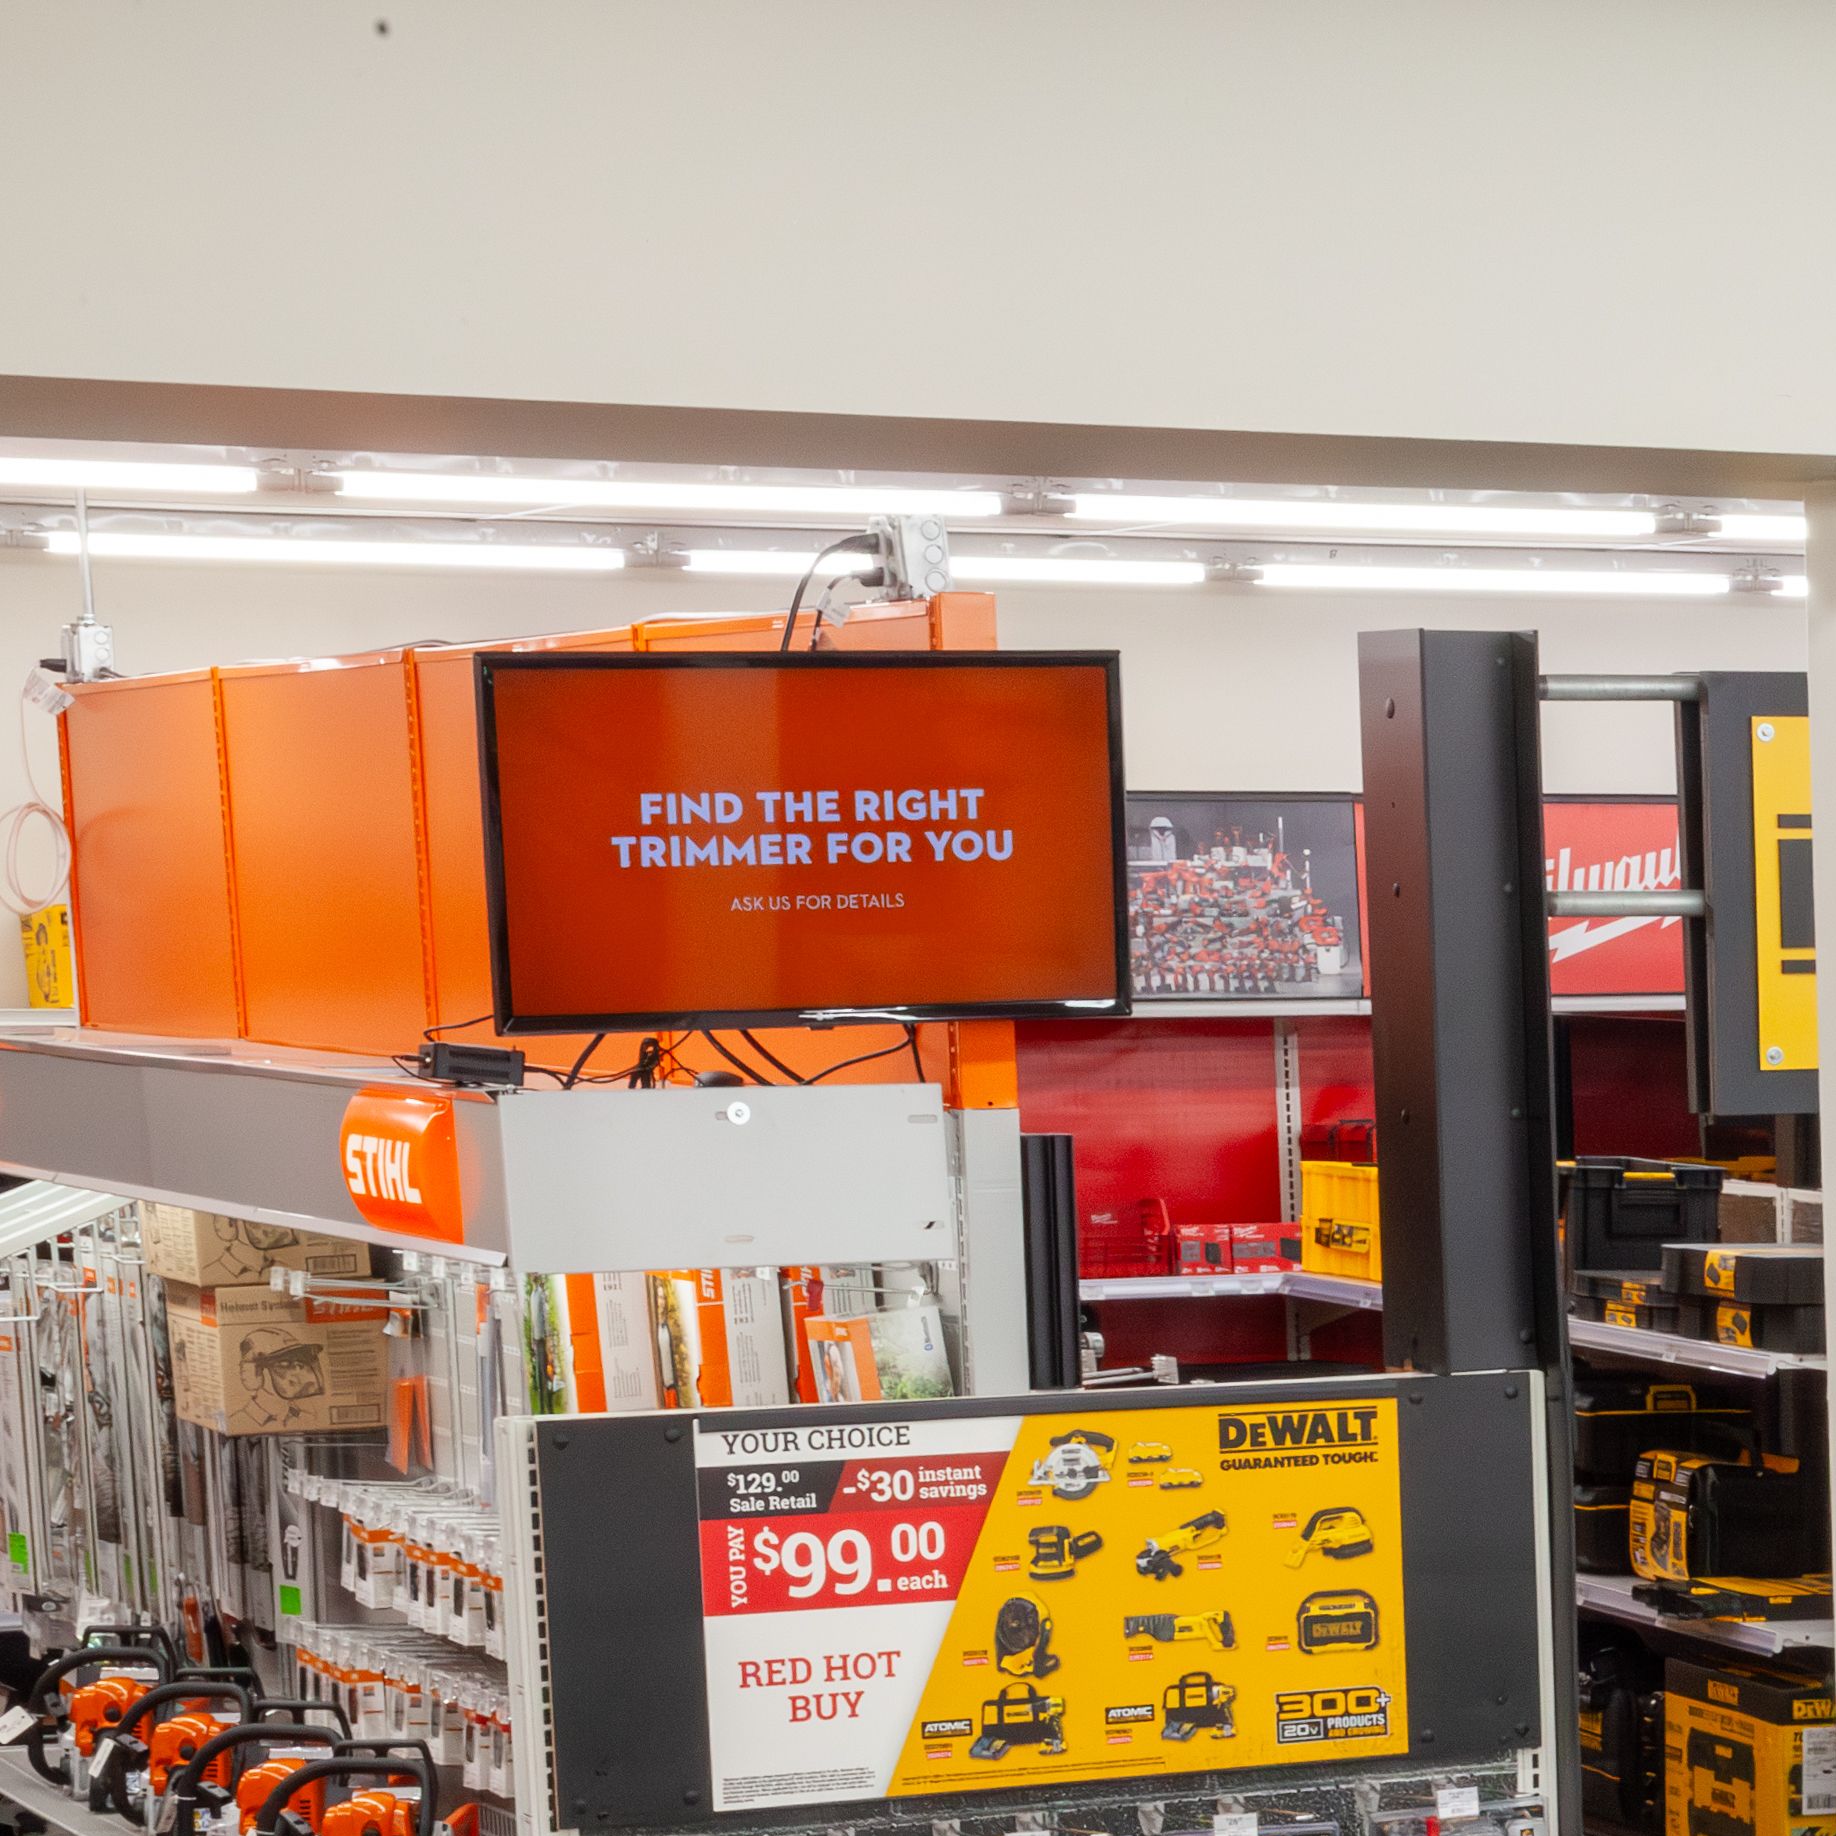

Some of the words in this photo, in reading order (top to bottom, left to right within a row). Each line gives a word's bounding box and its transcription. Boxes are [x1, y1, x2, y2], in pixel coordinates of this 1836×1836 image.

[640, 794, 743, 825] FIND
[756, 791, 840, 823] THE
[855, 788, 984, 821] RIGHT
[612, 834, 812, 868] TRIMMER
[827, 832, 912, 864] FOR
[925, 830, 1013, 861] YOU
[731, 896, 764, 912] ASK
[769, 896, 791, 910] US
[796, 895, 831, 910] FOR
[837, 893, 905, 908] DETAILS
[347, 1133, 422, 1205] STIHL
[722, 1431, 800, 1455] YOUR
[807, 1426, 910, 1450] CHOICE
[1218, 1409, 1377, 1449] DEWALT
[918, 1466, 981, 1482] instant
[1220, 1455, 1319, 1471] GUARANTEED
[730, 1496, 765, 1513] Sale
[769, 1495, 817, 1510] Retail
[920, 1480, 987, 1500] savings
[728, 1526, 745, 1561] PAY
[729, 1566, 748, 1608] YOU
[898, 1570, 948, 1591] each
[739, 1660, 812, 1688] RED
[824, 1651, 901, 1681] HOT
[789, 1691, 865, 1723] BUY
[1328, 1714, 1385, 1728] PRODUCTS
